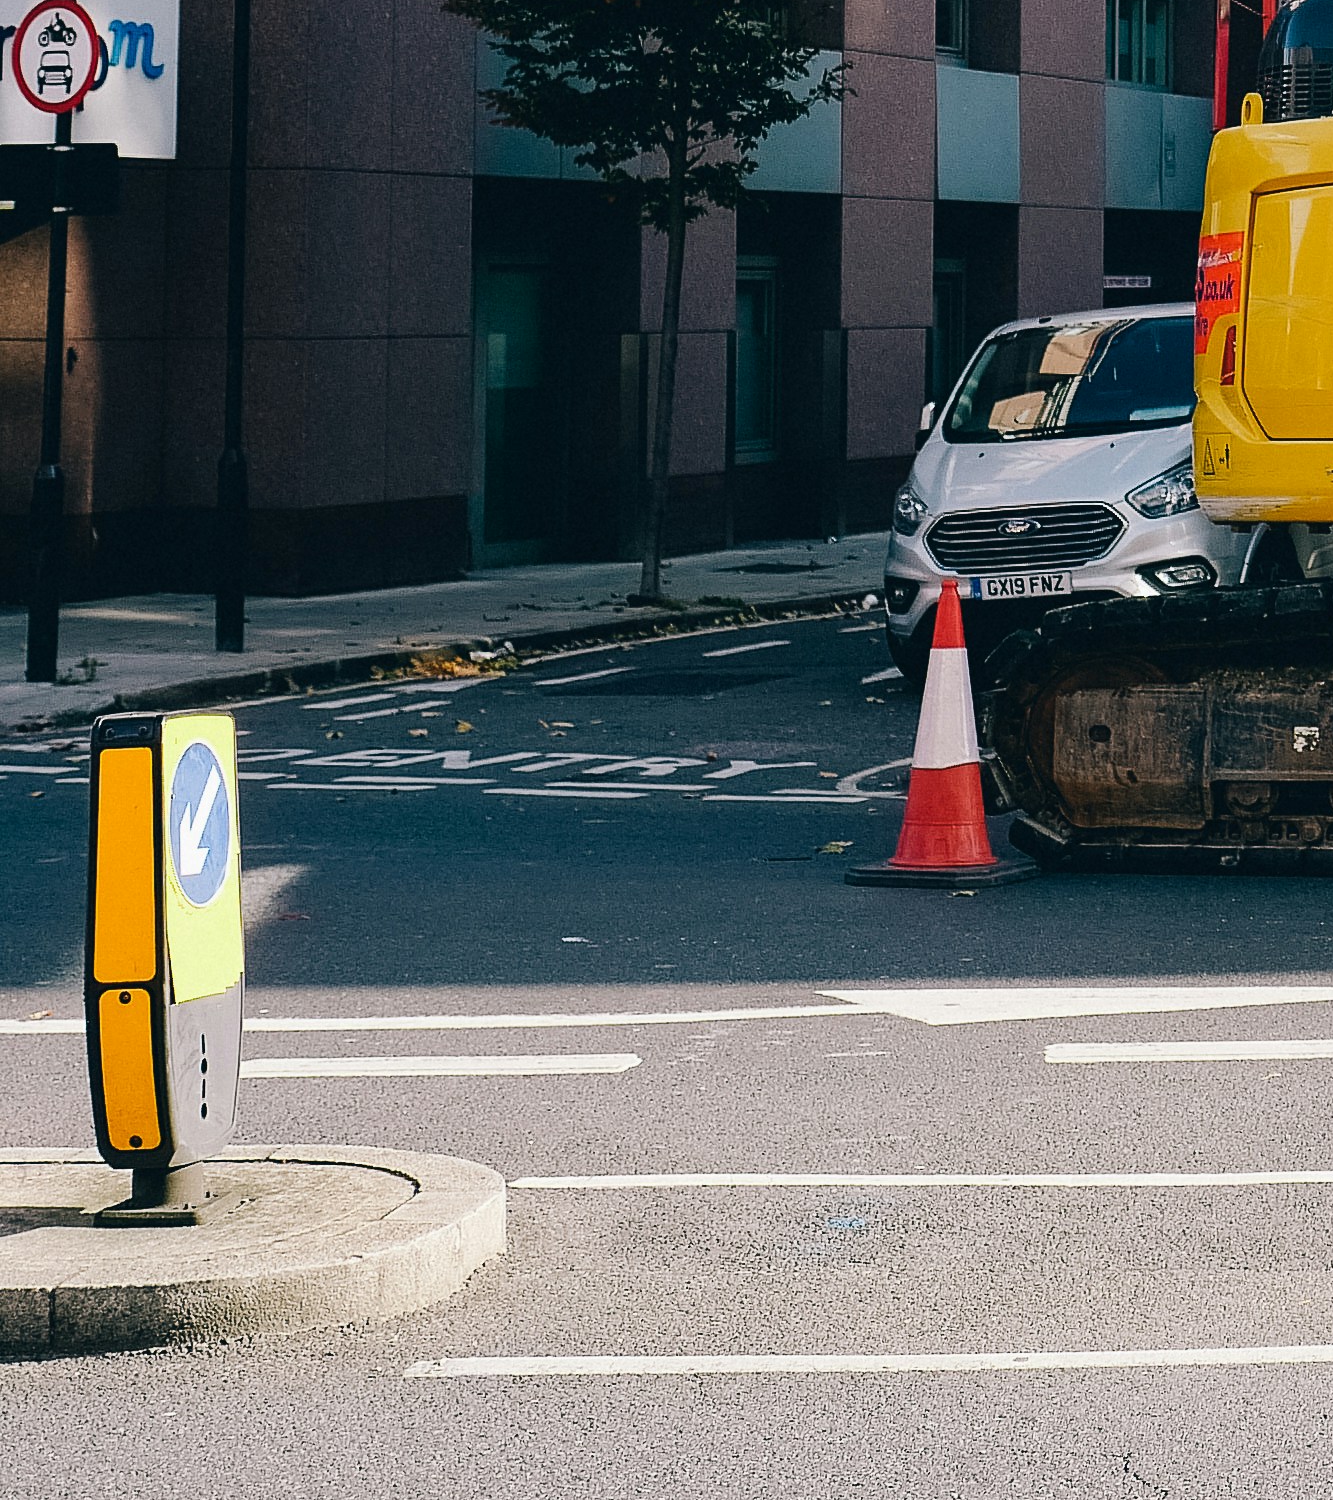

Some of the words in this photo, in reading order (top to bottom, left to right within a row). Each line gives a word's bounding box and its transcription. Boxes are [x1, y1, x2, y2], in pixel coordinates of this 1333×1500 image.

[987, 577, 1026, 597] GX19
[1029, 574, 1065, 594] FNZ
[291, 748, 818, 779] ENTRY
